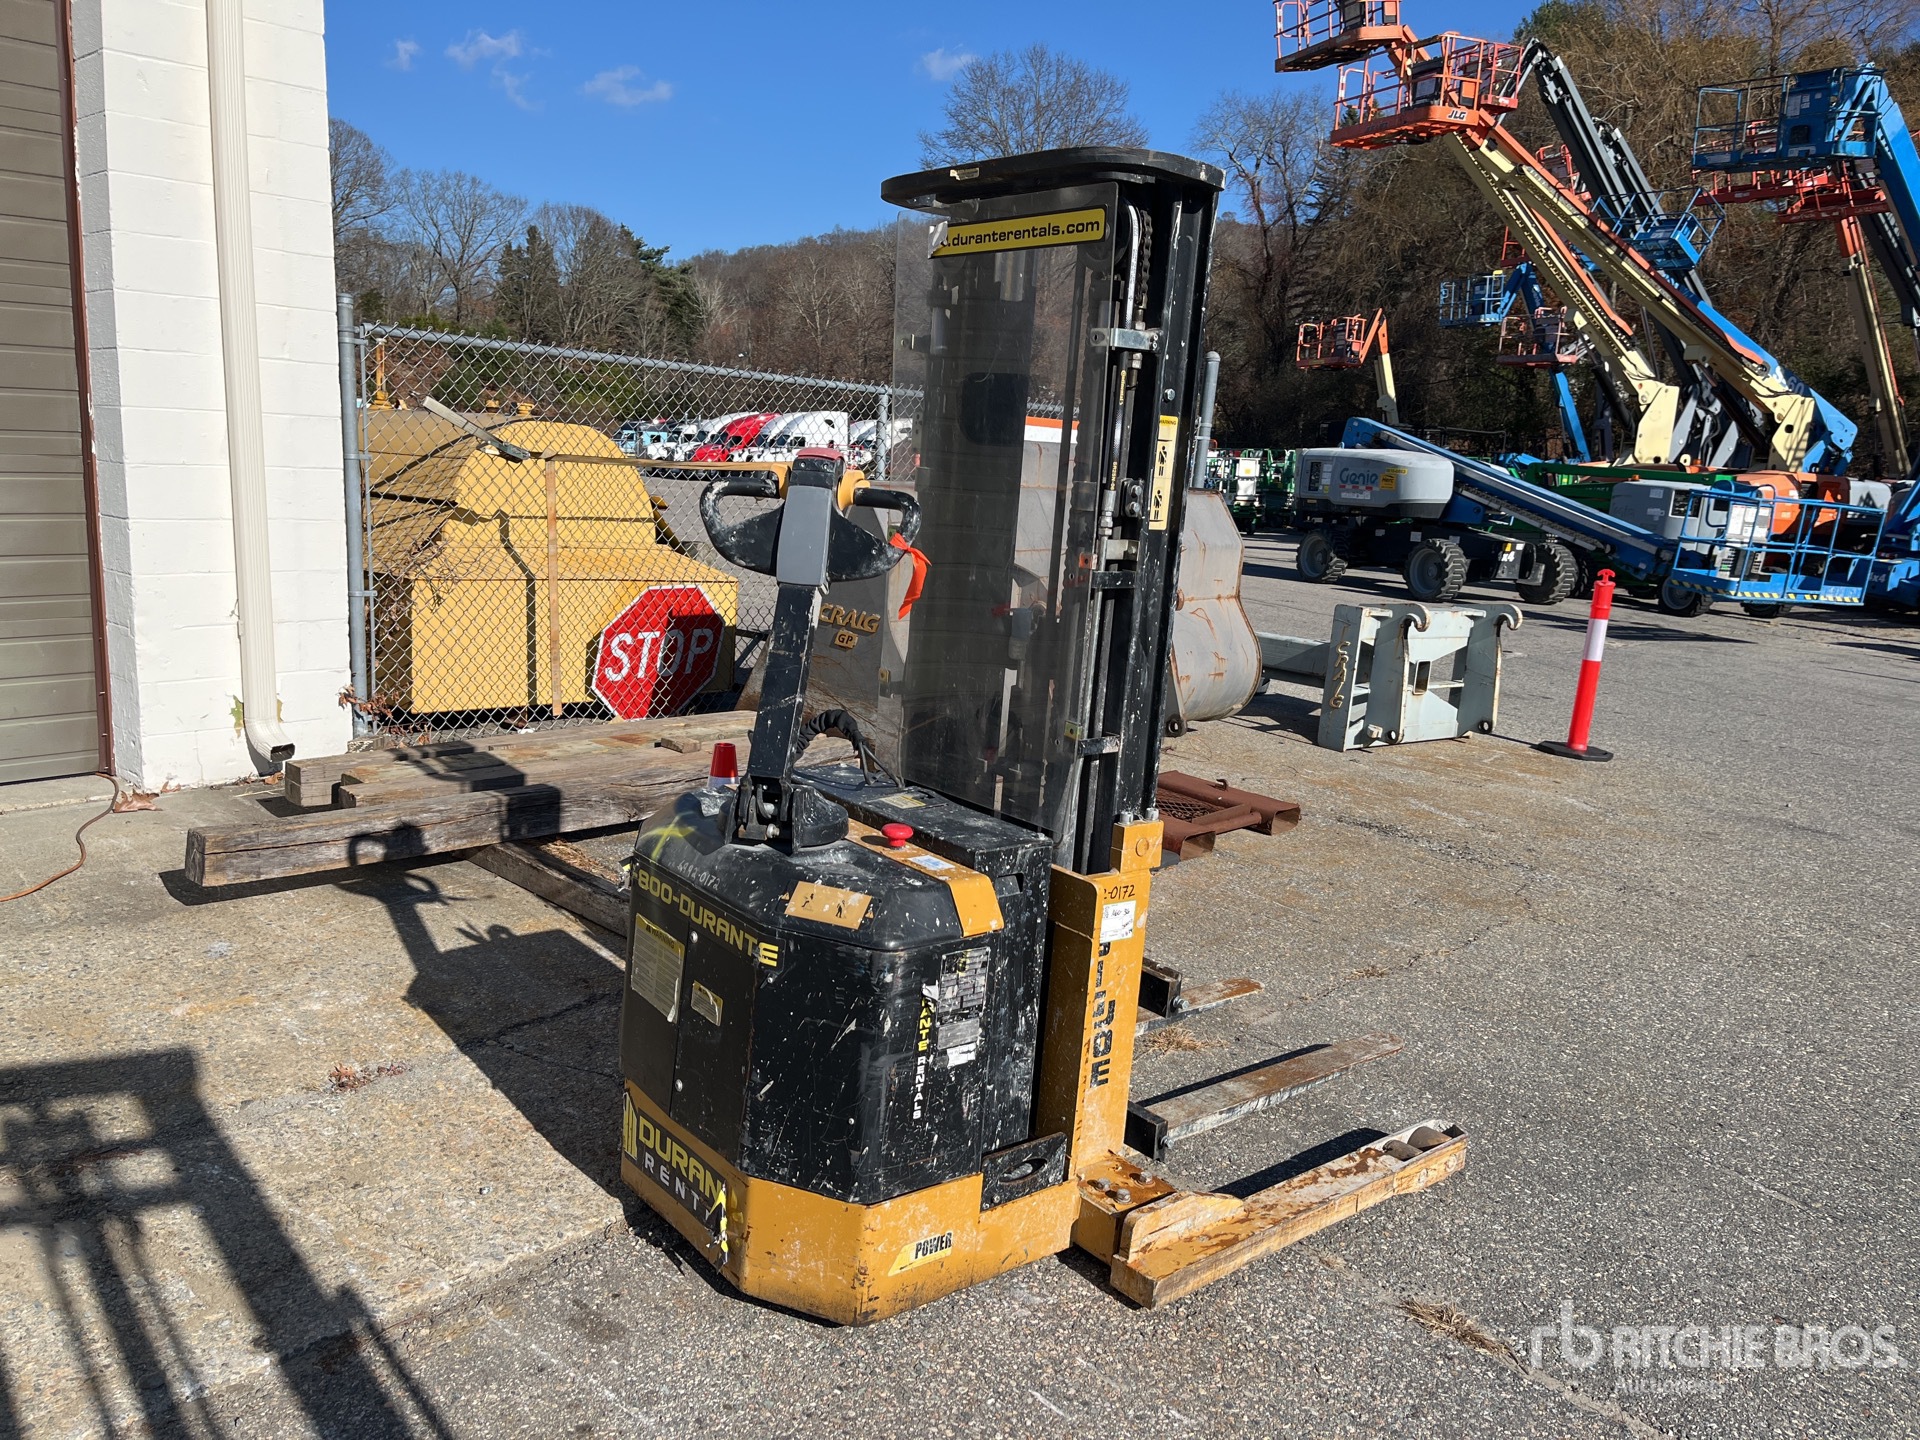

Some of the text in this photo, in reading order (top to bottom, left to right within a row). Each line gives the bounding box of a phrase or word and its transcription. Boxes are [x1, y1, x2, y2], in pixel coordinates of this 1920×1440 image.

[1448, 110, 1466, 120] JLG
[1340, 467, 1379, 485] Genie
[820, 603, 881, 634] CRAIG
[838, 634, 854, 645] GP
[605, 628, 714, 681] STOP
[1329, 641, 1351, 709] CRAIG
[912, 1056, 926, 1120] RENTALS
[915, 1232, 953, 1259] POWER
